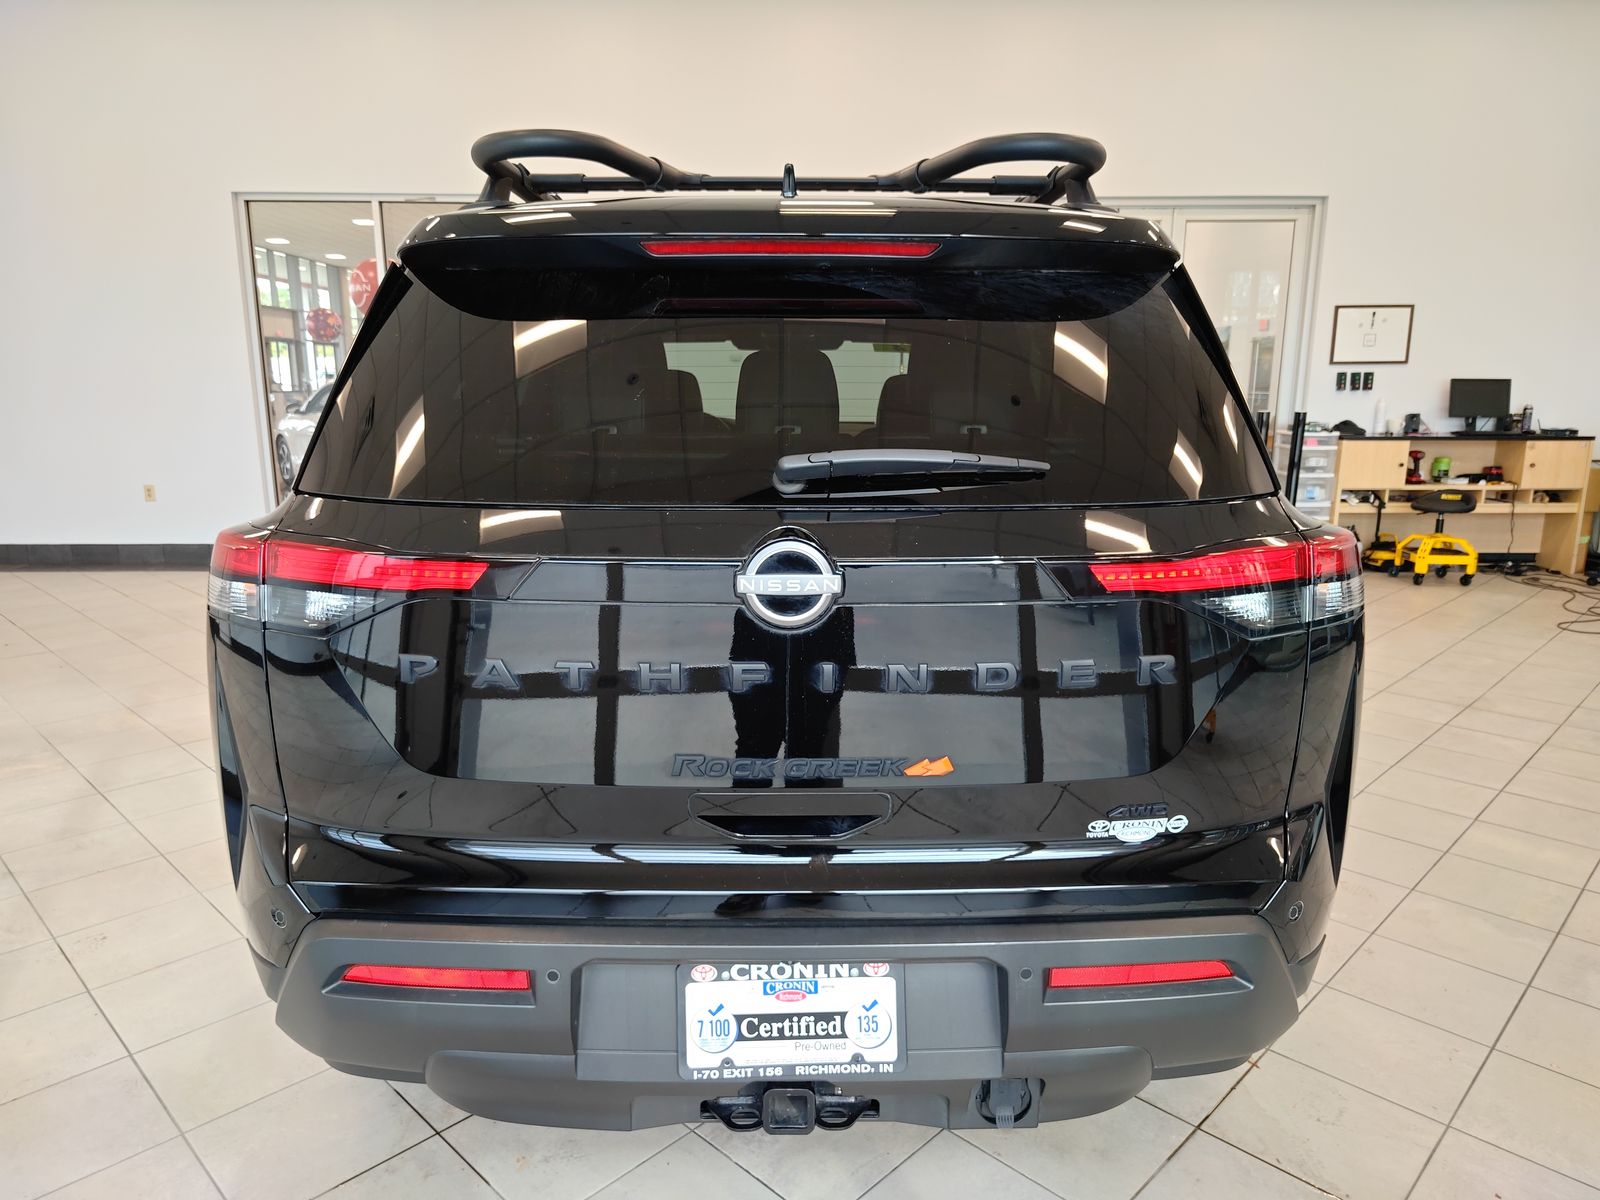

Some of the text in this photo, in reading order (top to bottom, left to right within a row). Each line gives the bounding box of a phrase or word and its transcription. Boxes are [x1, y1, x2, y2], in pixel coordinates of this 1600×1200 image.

[739, 578, 839, 592] NISSAN
[399, 653, 1177, 694] PATHFINDER
[731, 962, 849, 980] CRONIN
[765, 981, 815, 995] CRONIN
[697, 1019, 731, 1038] 7 100
[740, 1015, 843, 1039] Certified
[857, 1015, 879, 1033] 135
[794, 1040, 847, 1052] Pre-Owned
[693, 1063, 894, 1080] I-70 EXIT 156 RICHMOND, IN
